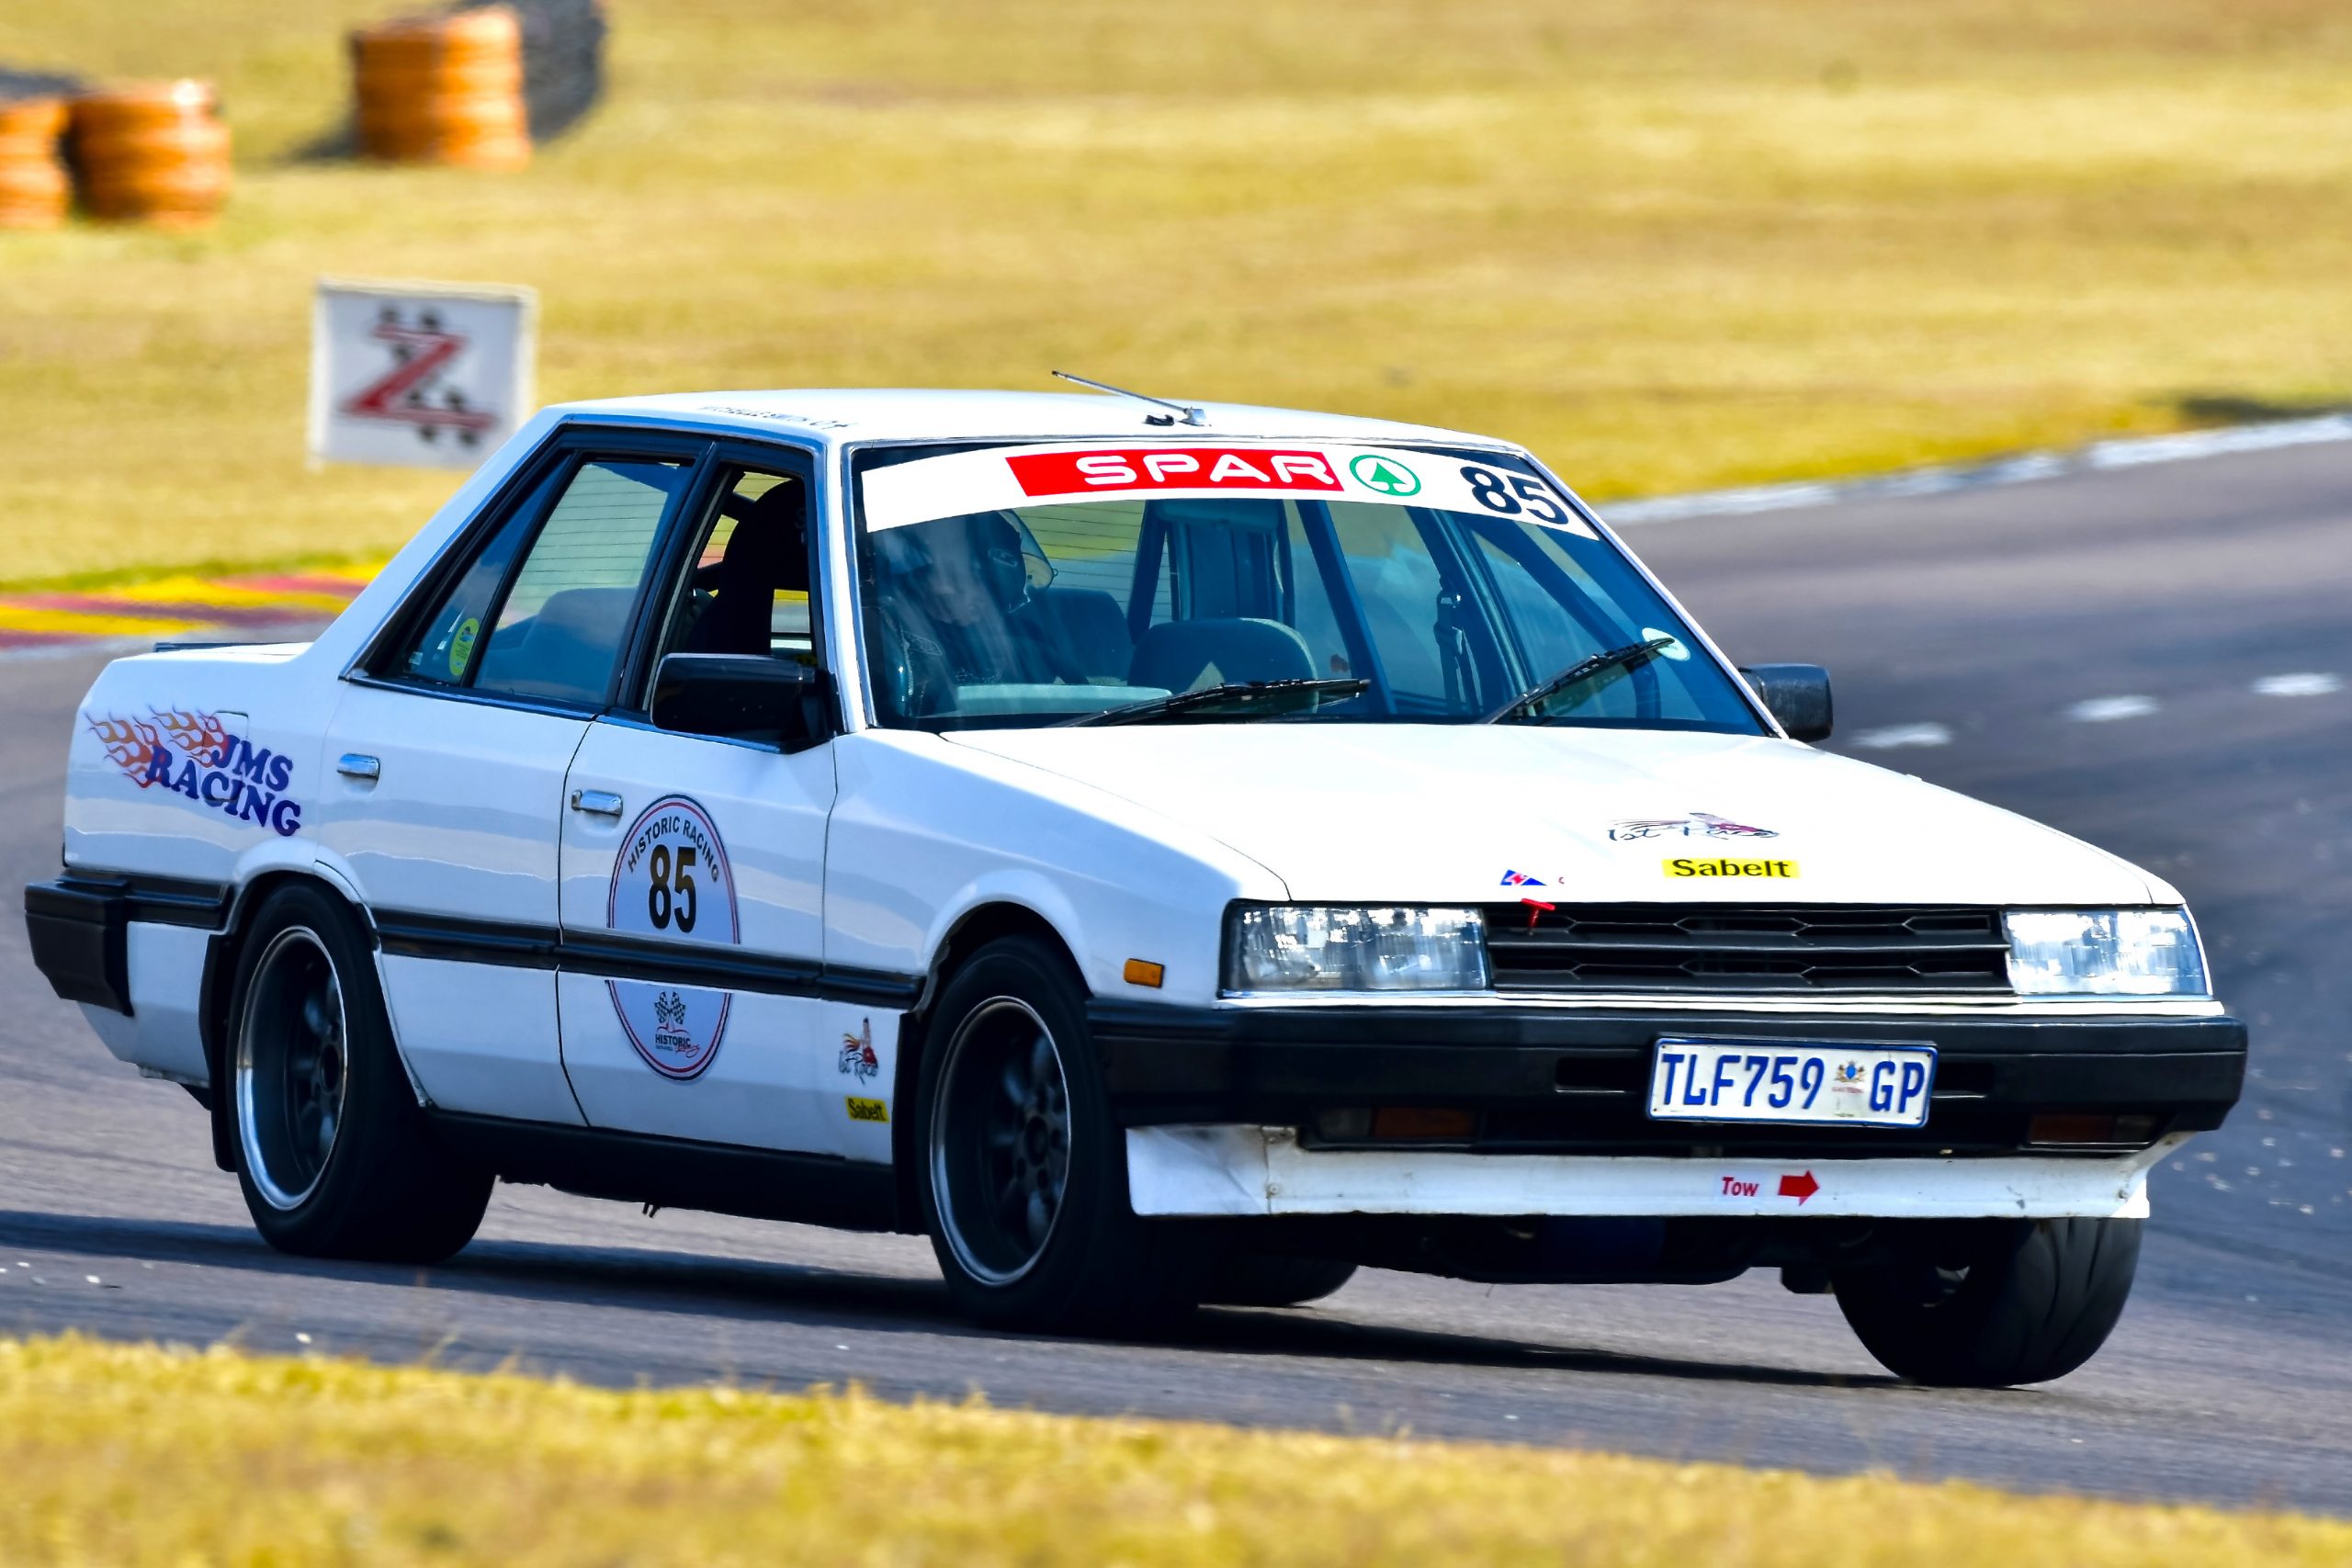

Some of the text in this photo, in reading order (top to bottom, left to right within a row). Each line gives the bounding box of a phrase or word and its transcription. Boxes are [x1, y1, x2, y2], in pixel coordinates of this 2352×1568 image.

[1076, 454, 1334, 485] SPAR
[1459, 466, 1569, 525] 85
[144, 745, 301, 837] RACING
[210, 734, 294, 792] JMS
[628, 816, 719, 883] HISTORIC RACING
[1672, 859, 1791, 878] Sabelt
[649, 844, 696, 933] 85
[655, 1033, 692, 1048] HISTORIC
[1661, 1053, 1926, 1113] TLF759 GP
[1722, 1176, 1760, 1198] Tow
